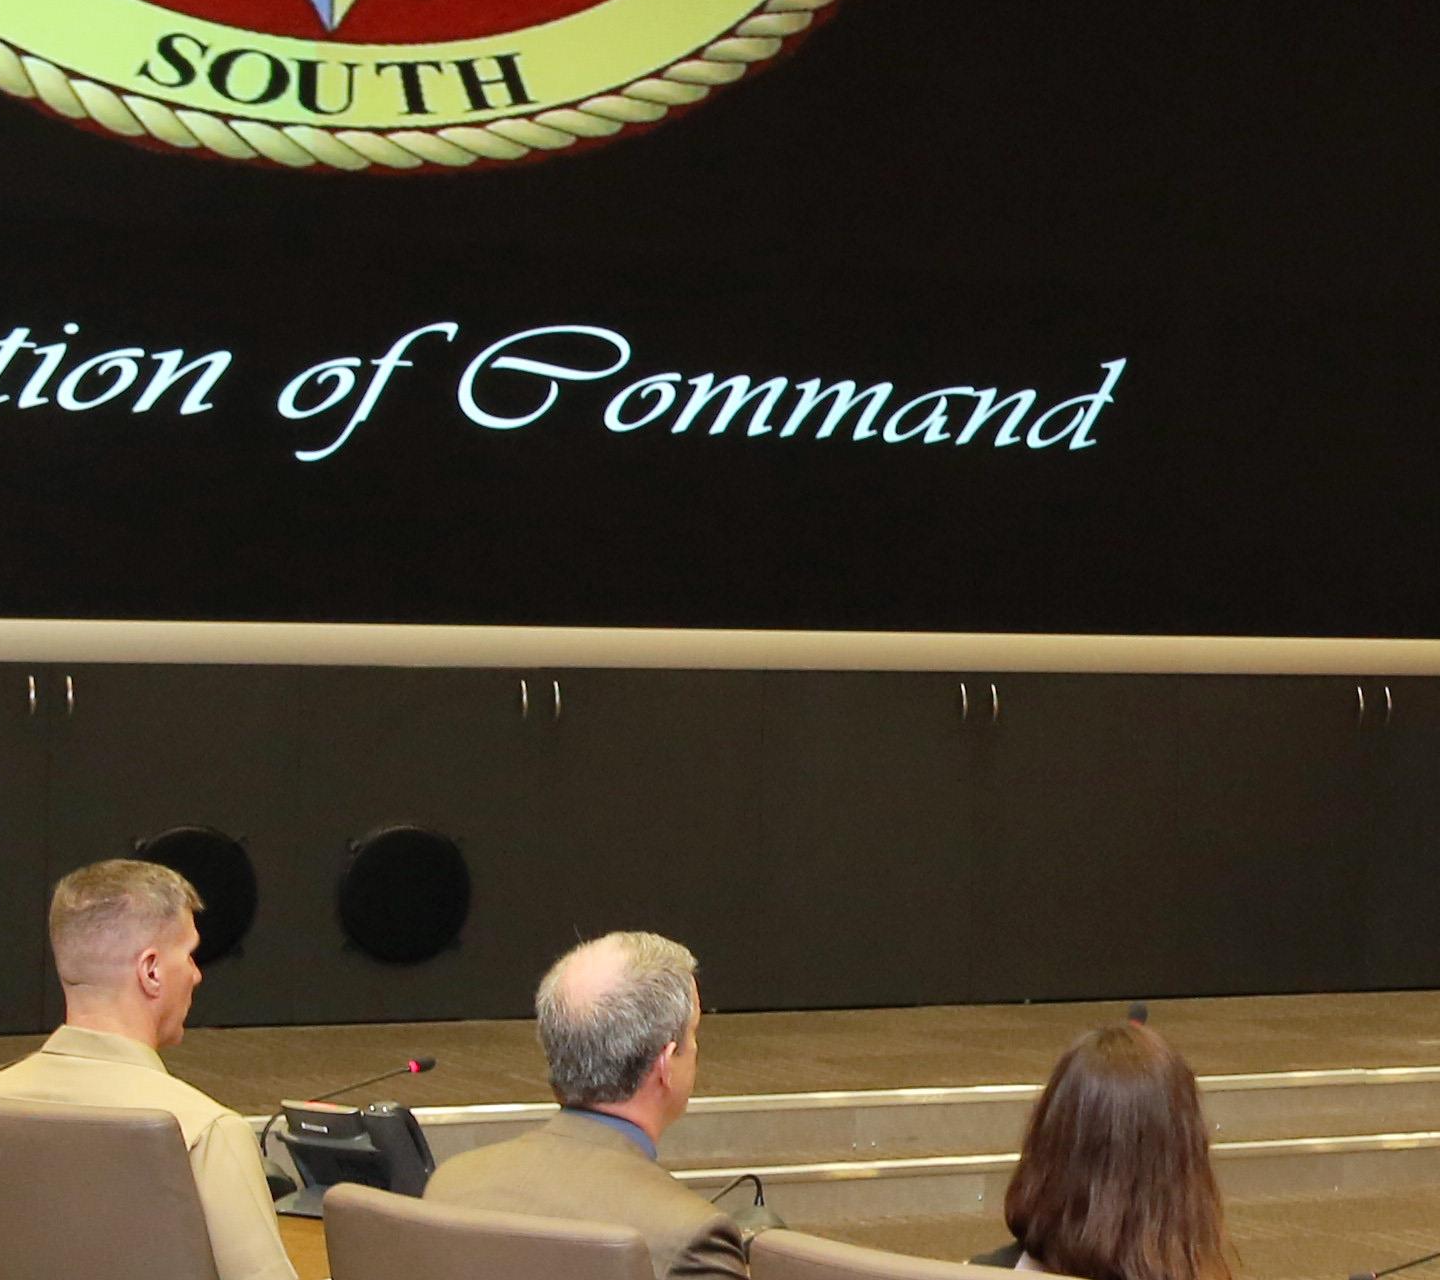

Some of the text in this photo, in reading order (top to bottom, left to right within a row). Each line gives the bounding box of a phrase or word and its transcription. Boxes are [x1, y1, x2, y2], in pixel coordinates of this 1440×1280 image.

[137, 32, 537, 117] SOUTH
[277, 321, 459, 462] of
[456, 323, 1127, 450] Command
